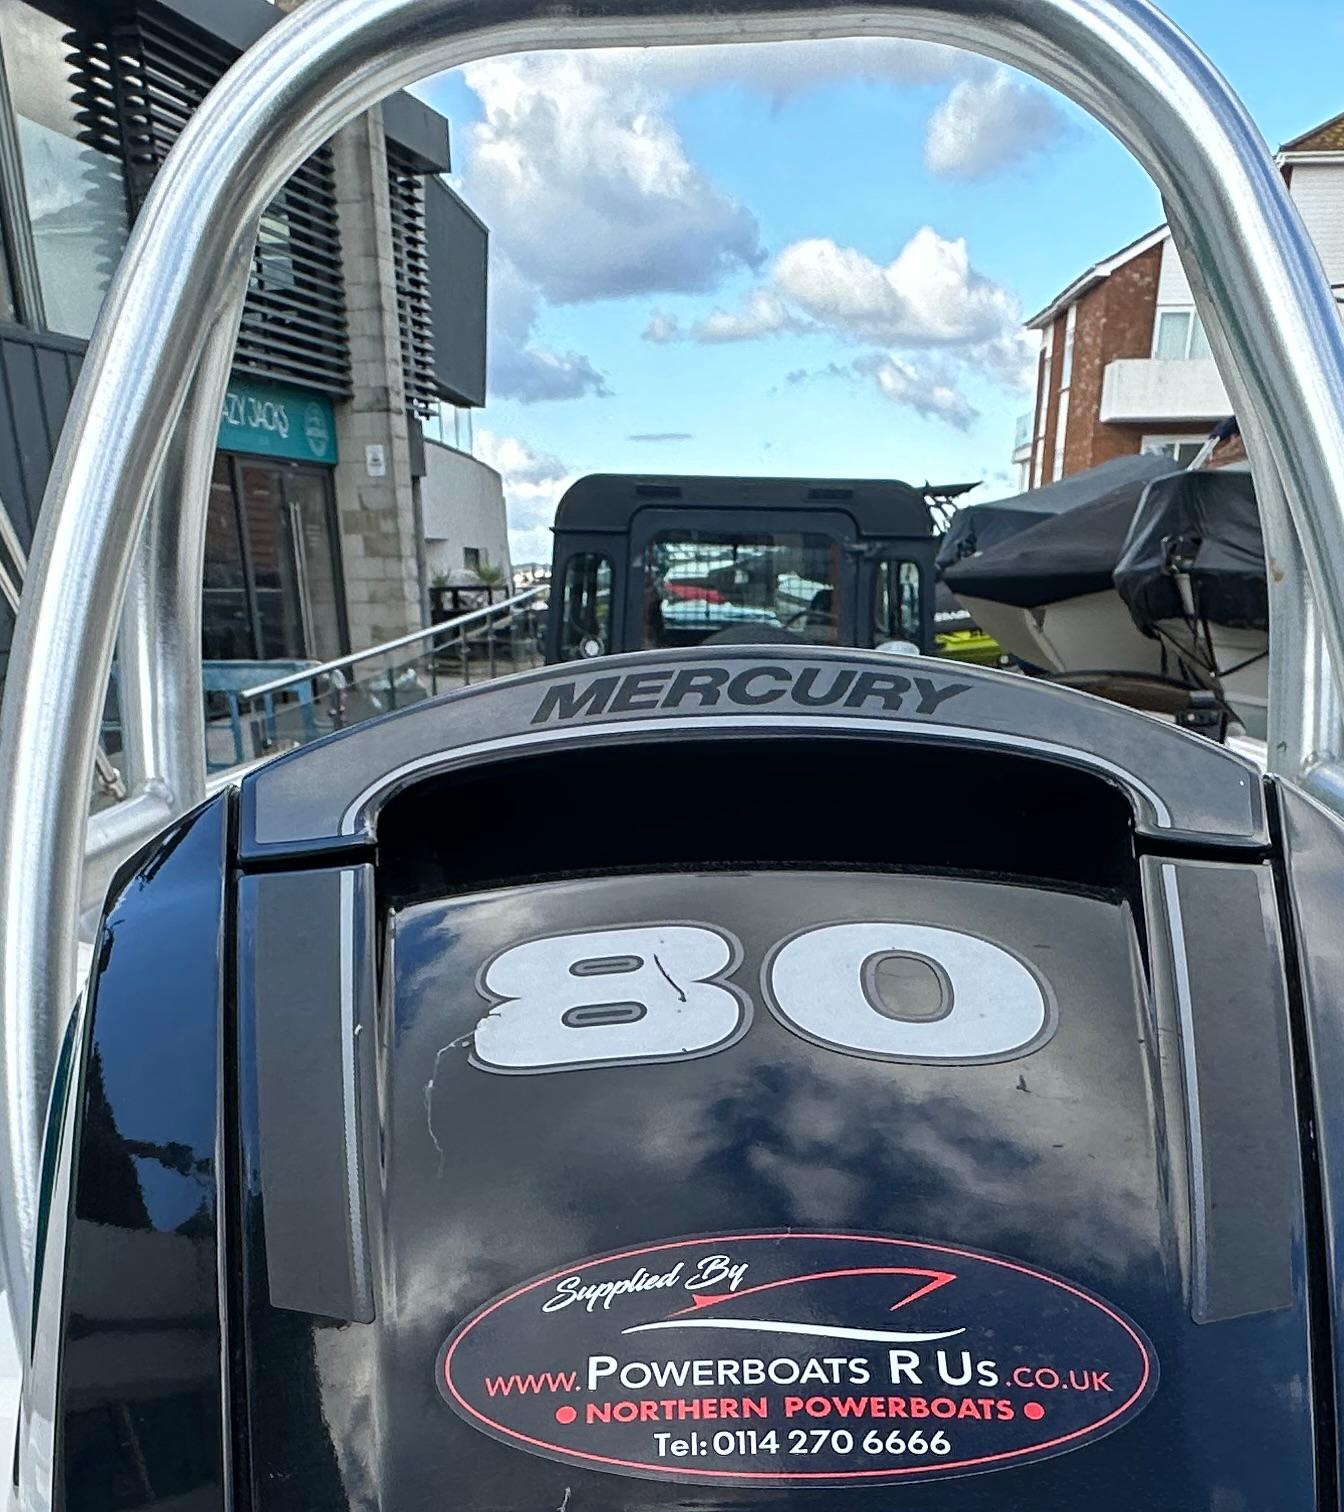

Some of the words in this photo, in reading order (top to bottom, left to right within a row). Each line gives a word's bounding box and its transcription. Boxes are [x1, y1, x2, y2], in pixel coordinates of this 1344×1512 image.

[530, 665, 973, 725] MERCURY
[467, 919, 1058, 1075] 80
[542, 1262, 686, 1313] Supplied
[684, 1254, 749, 1292] By
[889, 1349, 924, 1385] R
[585, 1397, 769, 1425] NORTHERN
[784, 1396, 1016, 1422] POWERBOATS
[787, 1430, 855, 1455] 270
[862, 1429, 952, 1456] 6666
